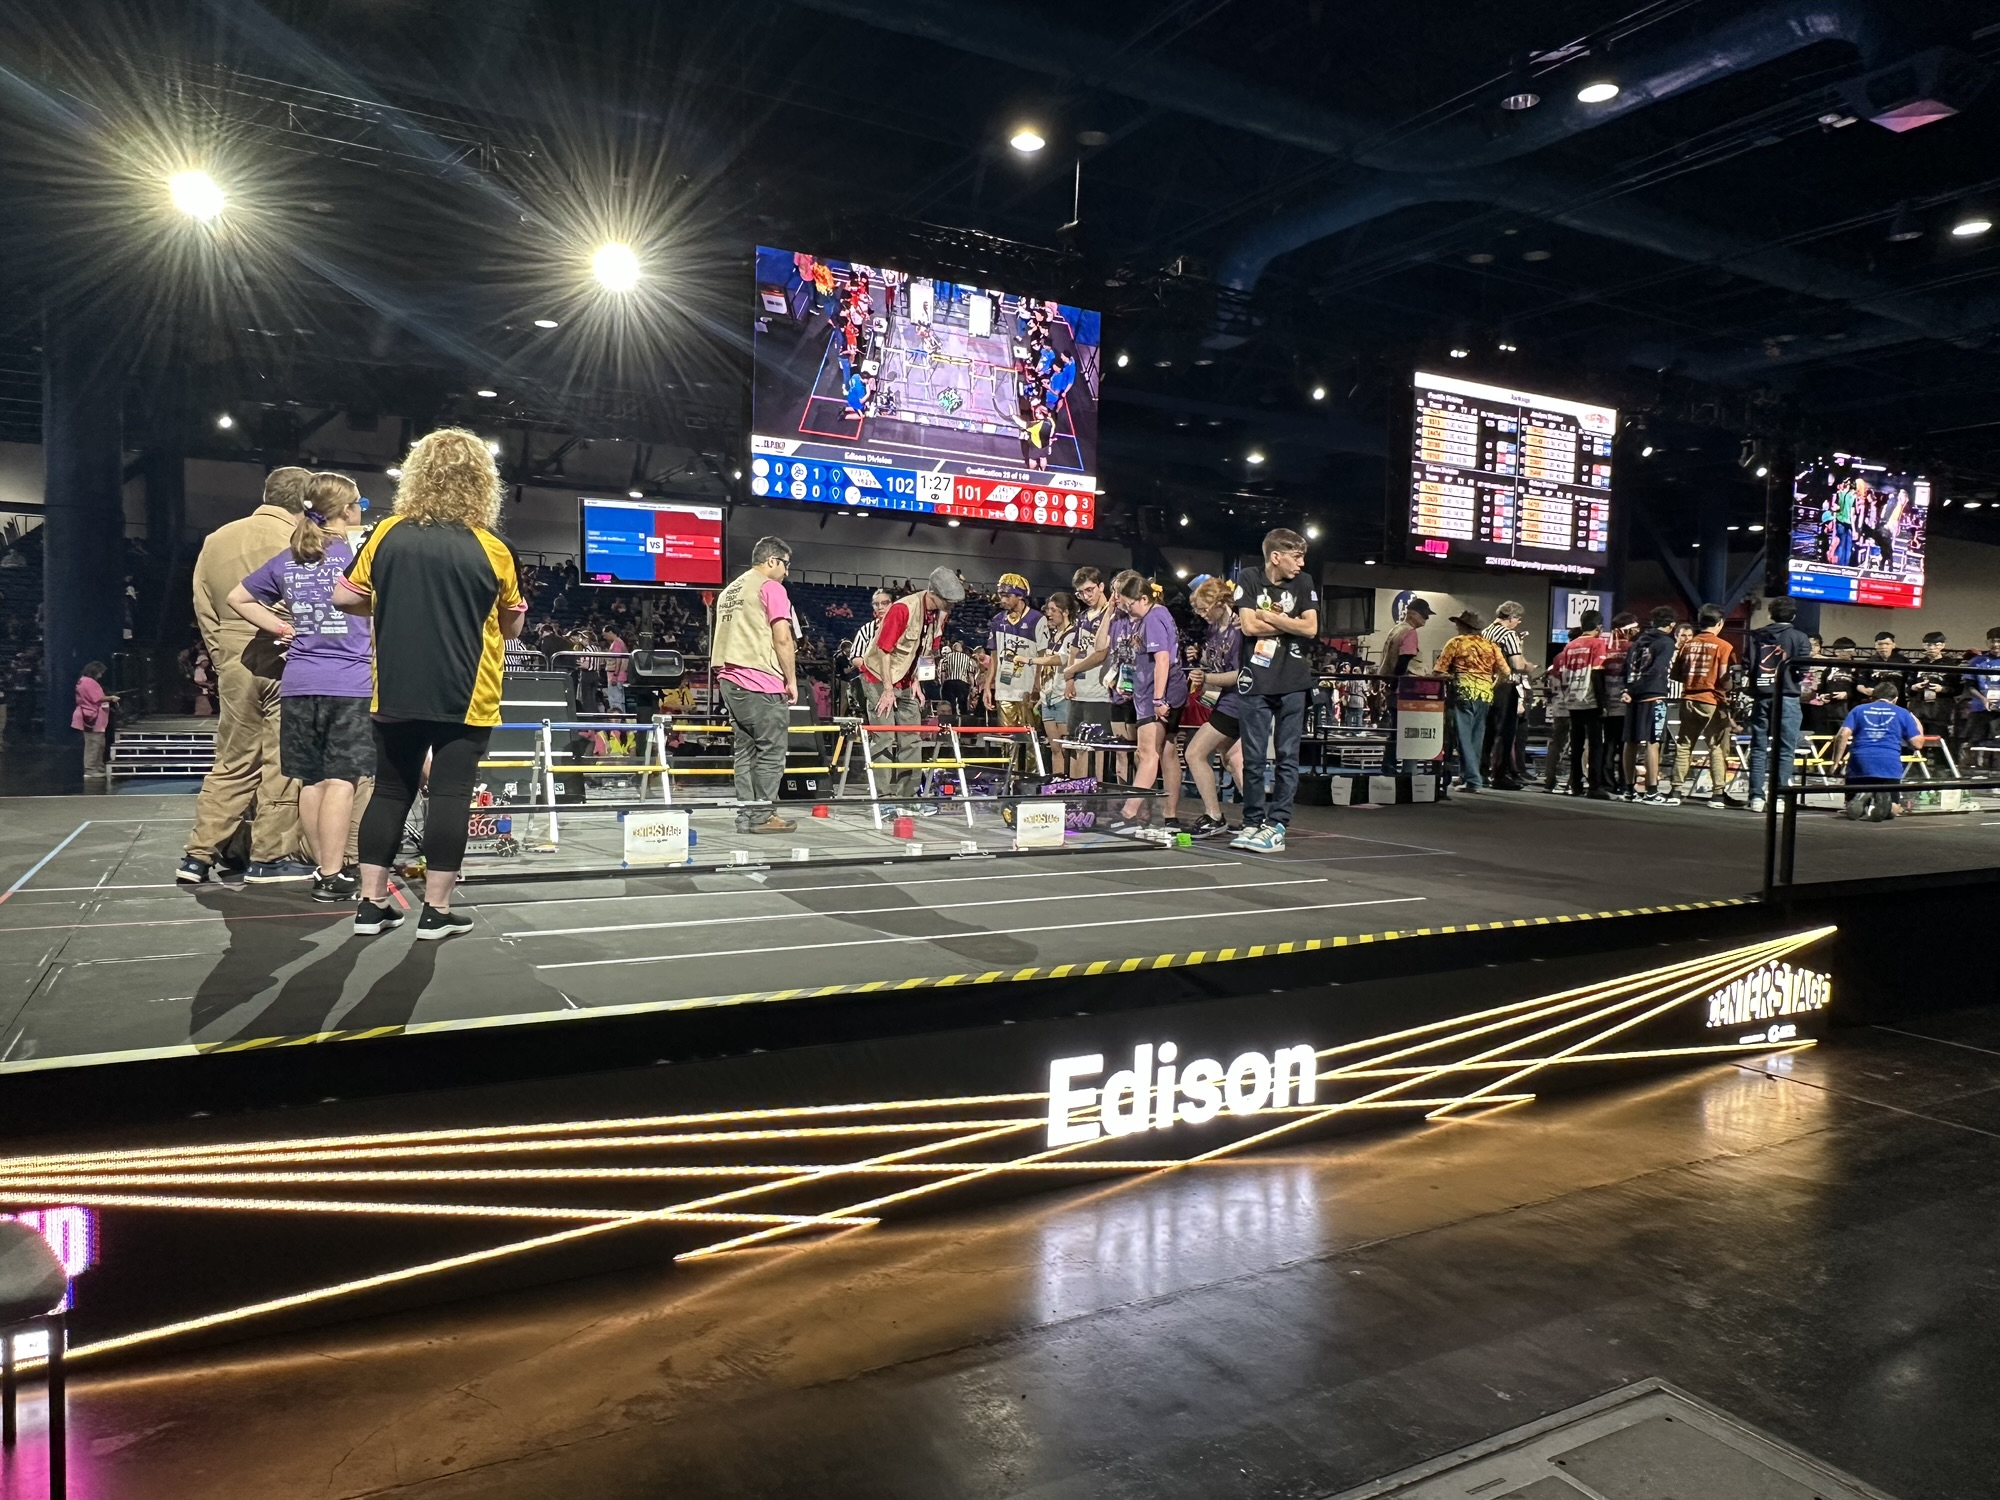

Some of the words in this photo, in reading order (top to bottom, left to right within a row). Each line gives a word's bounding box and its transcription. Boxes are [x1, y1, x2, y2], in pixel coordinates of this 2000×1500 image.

[775, 463, 783, 475] 0
[813, 468, 819, 480] 1
[774, 481, 783, 494] 4
[812, 486, 820, 498] 0
[886, 477, 914, 494] 102
[921, 475, 951, 491] 1:27
[956, 485, 981, 501] 101
[1052, 494, 1059, 506] 0
[1082, 498, 1088, 509] 3
[1051, 511, 1058, 522] 0
[1081, 514, 1088, 525] 5
[649, 541, 660, 549] VS
[1571, 597, 1597, 615] 1:27
[1047, 1041, 1317, 1147] Edison
